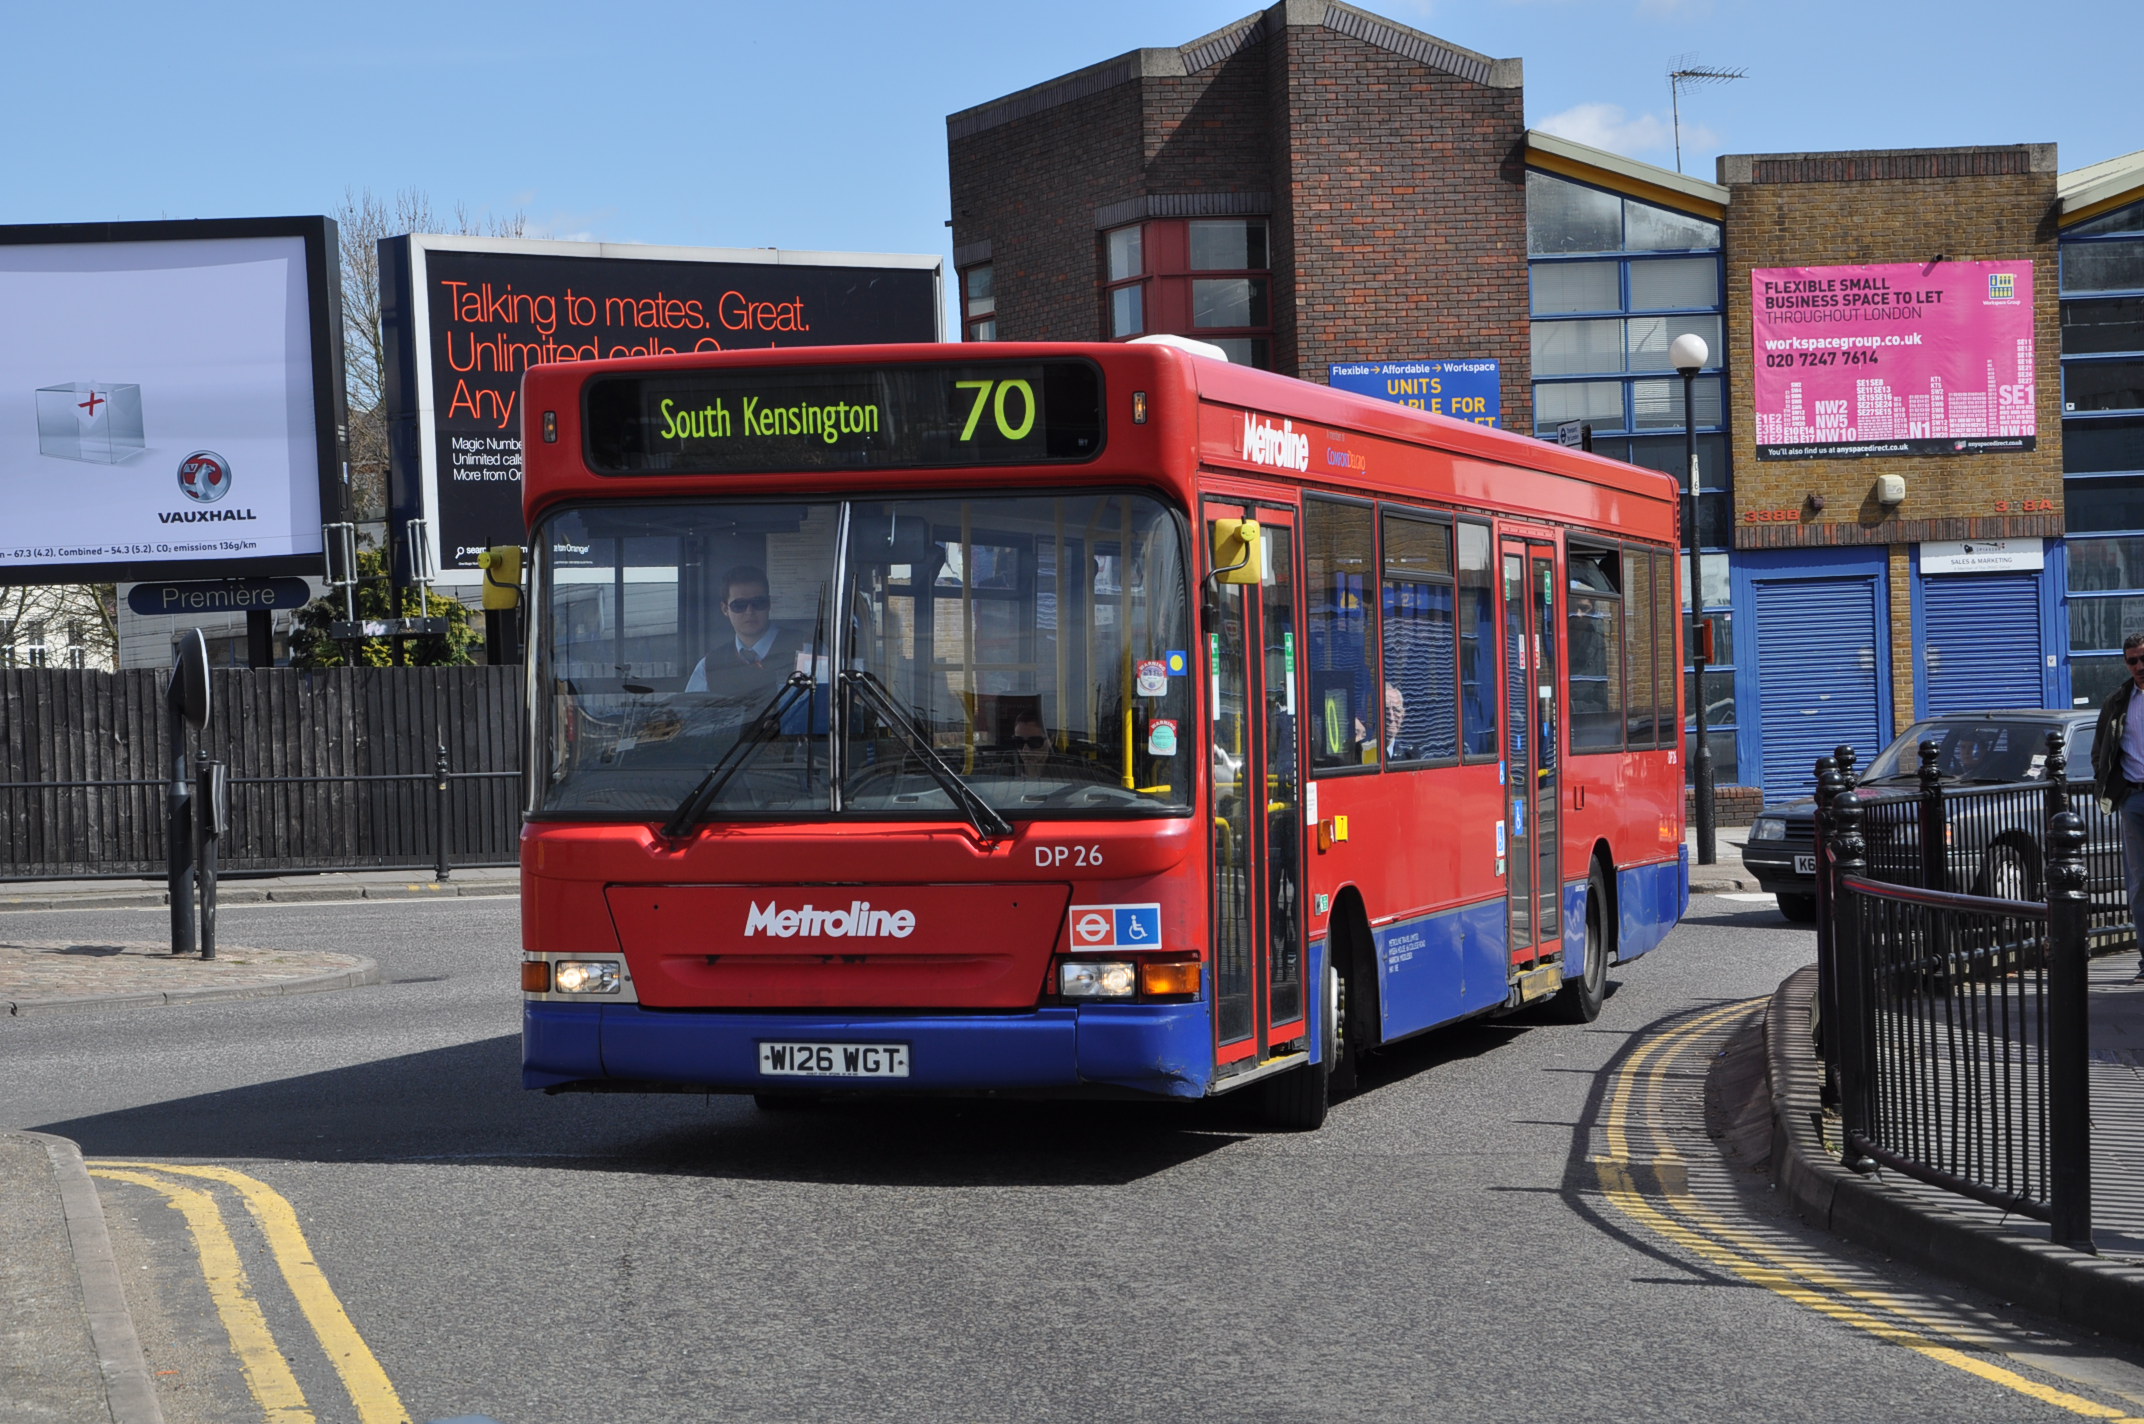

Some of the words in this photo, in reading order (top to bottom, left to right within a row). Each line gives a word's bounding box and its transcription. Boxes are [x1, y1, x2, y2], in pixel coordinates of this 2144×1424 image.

[1765, 280, 1836, 294] FLEXIBLE
[1840, 278, 1890, 291] SMALL
[441, 281, 556, 334] Talking
[564, 288, 596, 326] to
[605, 292, 709, 328] mates.
[719, 290, 809, 331] Great.
[1766, 294, 1839, 309] BUSINESS
[1842, 293, 1889, 306] SPACE
[1893, 292, 1912, 304] TO
[1916, 291, 1943, 303] LET
[1765, 309, 1861, 324] THROUGHOUT
[1864, 307, 1922, 321] LONDON
[1765, 332, 1922, 351] workspacegroup.co.uk
[447, 331, 599, 372] Unlimited
[1766, 354, 1794, 368] 020
[1799, 352, 1837, 366] 7247
[1841, 351, 1879, 365] 7614
[1332, 366, 1369, 376] Flexible
[1382, 364, 1430, 374] Affordable
[1443, 363, 1496, 373] Workspace
[1387, 378, 1442, 394] UNITS
[449, 378, 516, 428] Any
[1999, 385, 2034, 405] SE1
[955, 379, 1035, 441] 70
[1452, 397, 1486, 413] FOR
[1815, 400, 1848, 414] NW2
[661, 398, 731, 439] South
[743, 396, 879, 444] Kensington
[1756, 413, 1767, 424] E1
[1769, 413, 1782, 424] E2
[1816, 414, 1848, 428] NW5
[1756, 424, 1768, 435] E3
[1769, 424, 1782, 434] E8
[1784, 427, 1799, 436] E10
[1800, 426, 1814, 435] E14
[1816, 428, 1857, 442] NW10
[1910, 421, 1930, 438] N1
[2000, 425, 2034, 437] NW10
[452, 437, 484, 452] Magic
[1242, 409, 1309, 472] Metroline
[1756, 435, 1768, 445] E1
[1769, 434, 1783, 444] E2
[1784, 436, 1799, 444] E15
[1800, 435, 1815, 443] E17
[1768, 448, 1787, 456] You'll
[1836, 443, 1908, 454] anyspacedirect.co.uk
[453, 453, 500, 466] Unlimited
[453, 468, 482, 481] More
[483, 468, 507, 481] from
[158, 509, 256, 524] VAUXHALL
[1745, 509, 1800, 522] 338B
[14, 549, 32, 558] 67.3
[34, 547, 56, 558] (4.2),
[58, 547, 102, 557] Combined
[111, 546, 130, 555] 54.3
[132, 544, 154, 554] (5.2).
[173, 542, 217, 552] emissions
[219, 541, 257, 551] 136g/km
[162, 585, 275, 608] Première
[1139, 661, 1166, 671] WARNING
[1151, 720, 1176, 730] WARNING
[1035, 847, 1068, 867] DP
[1073, 845, 1103, 866] 26
[744, 900, 916, 938] Metroline
[770, 1046, 834, 1072] W126
[843, 1047, 900, 1074] WGT
